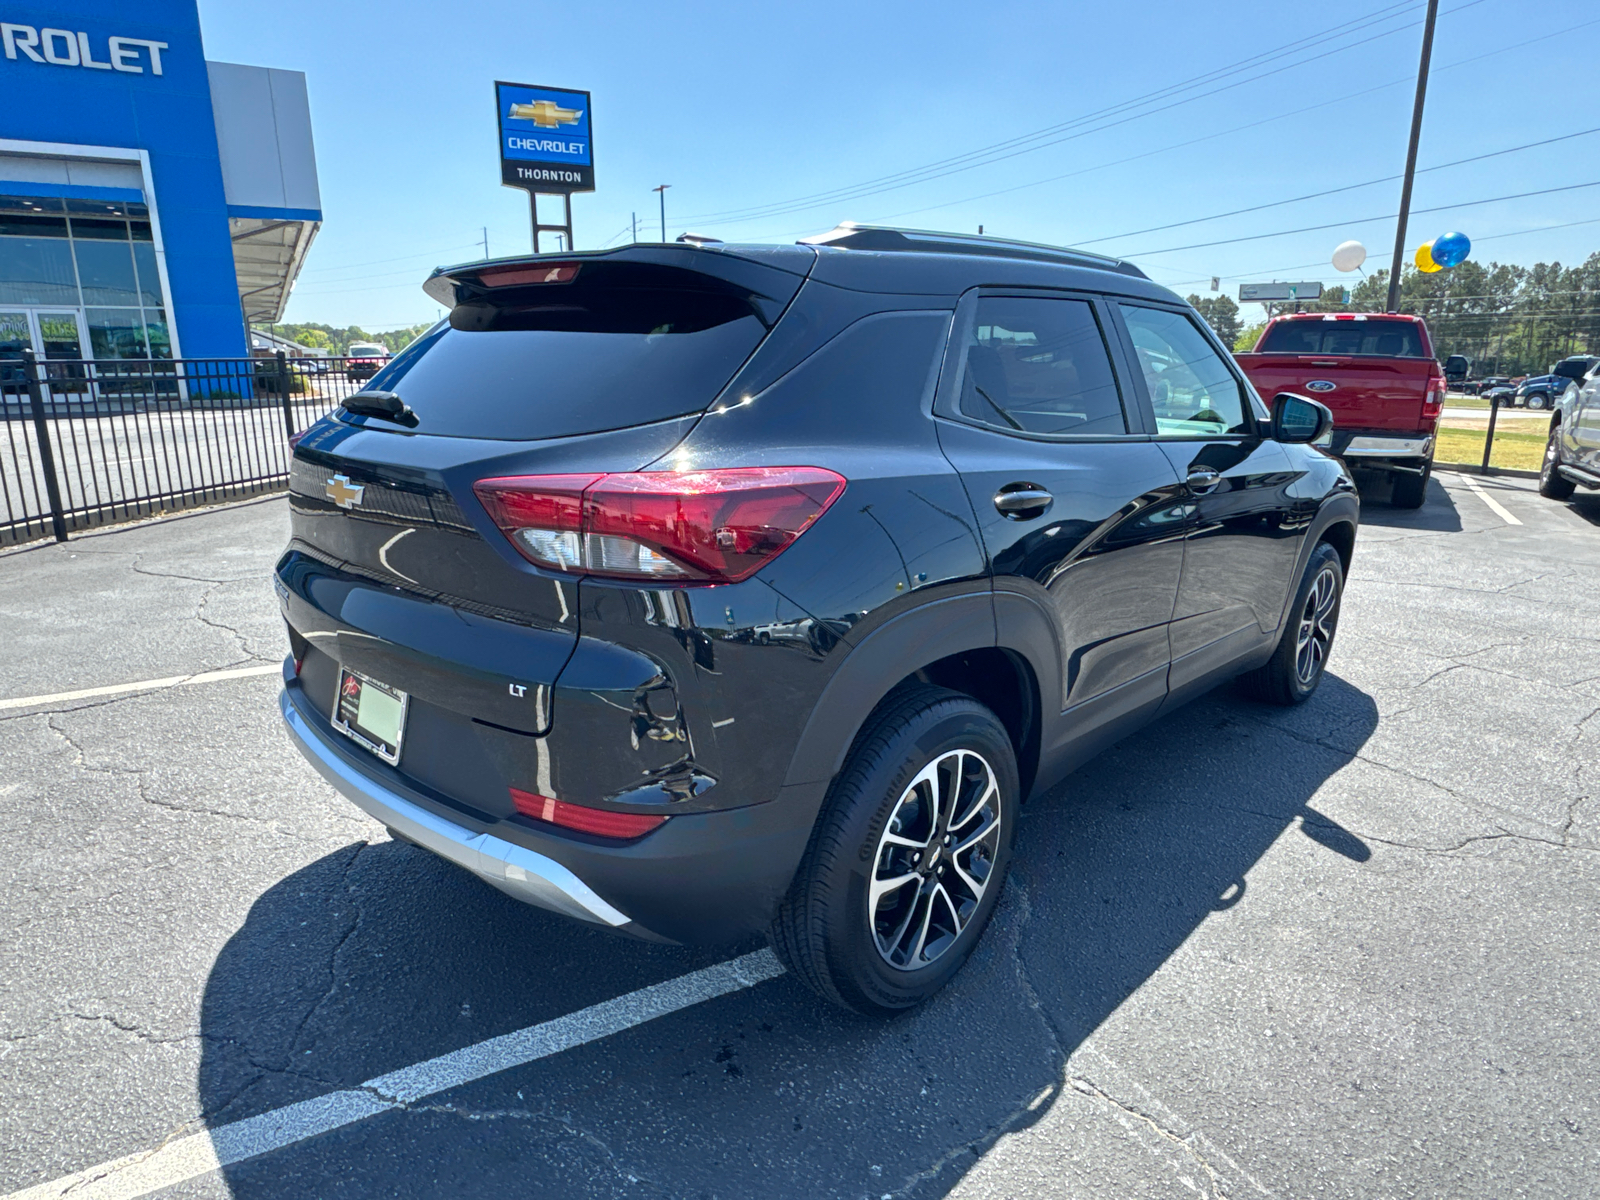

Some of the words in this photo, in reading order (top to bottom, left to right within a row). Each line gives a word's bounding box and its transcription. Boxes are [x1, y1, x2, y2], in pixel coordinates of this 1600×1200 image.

[0, 22, 169, 76] ROLET
[507, 137, 585, 155] CHEVROLET
[516, 167, 582, 183] THORNTON
[508, 683, 528, 698] LT
